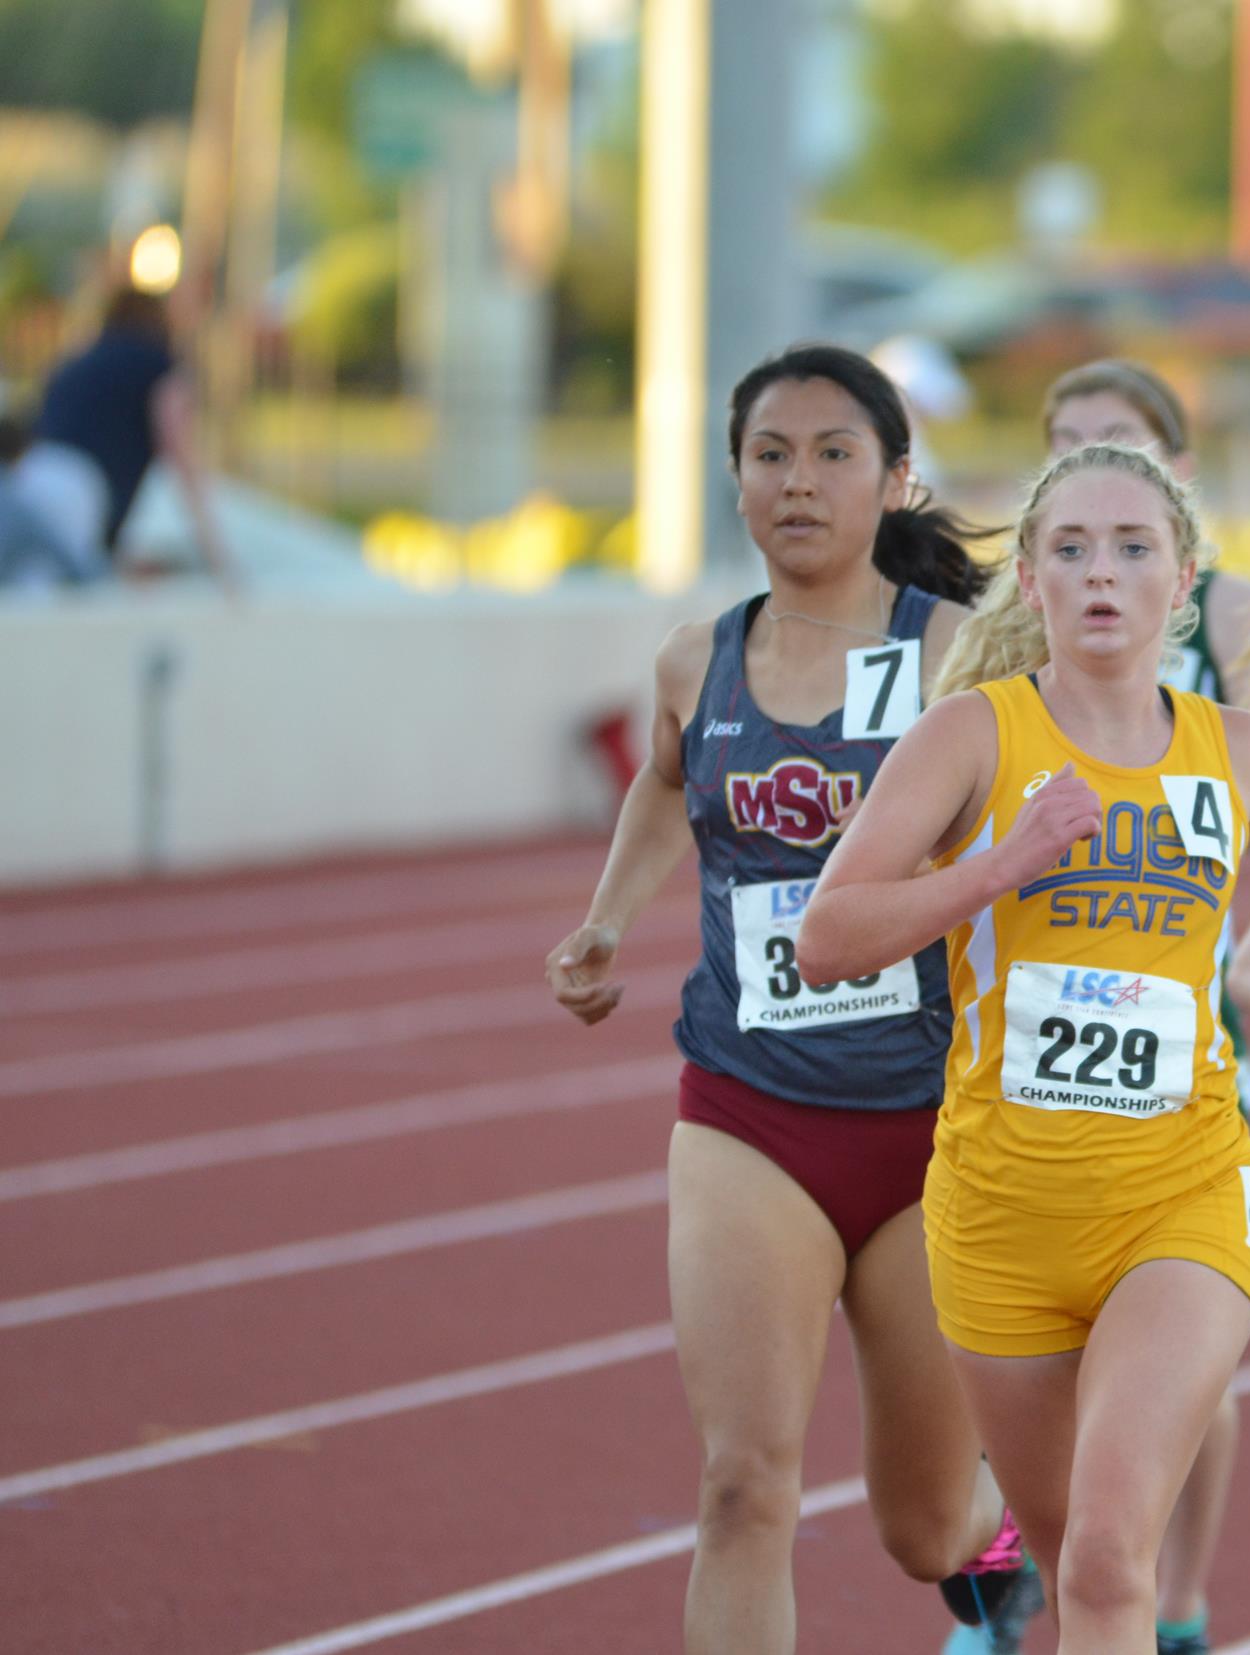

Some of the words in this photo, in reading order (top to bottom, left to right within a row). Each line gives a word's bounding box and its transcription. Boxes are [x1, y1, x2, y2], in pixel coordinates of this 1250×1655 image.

[863, 648, 904, 731] 7
[726, 757, 862, 848] MSU
[1191, 781, 1229, 862] 4
[1049, 889, 1196, 937] STATE
[760, 992, 900, 1023] CHAMPIONSHIPS
[1061, 969, 1121, 1009] LSC
[1035, 1016, 1159, 1090] 229
[1020, 1086, 1168, 1111] CHAMPIONSHIPS
